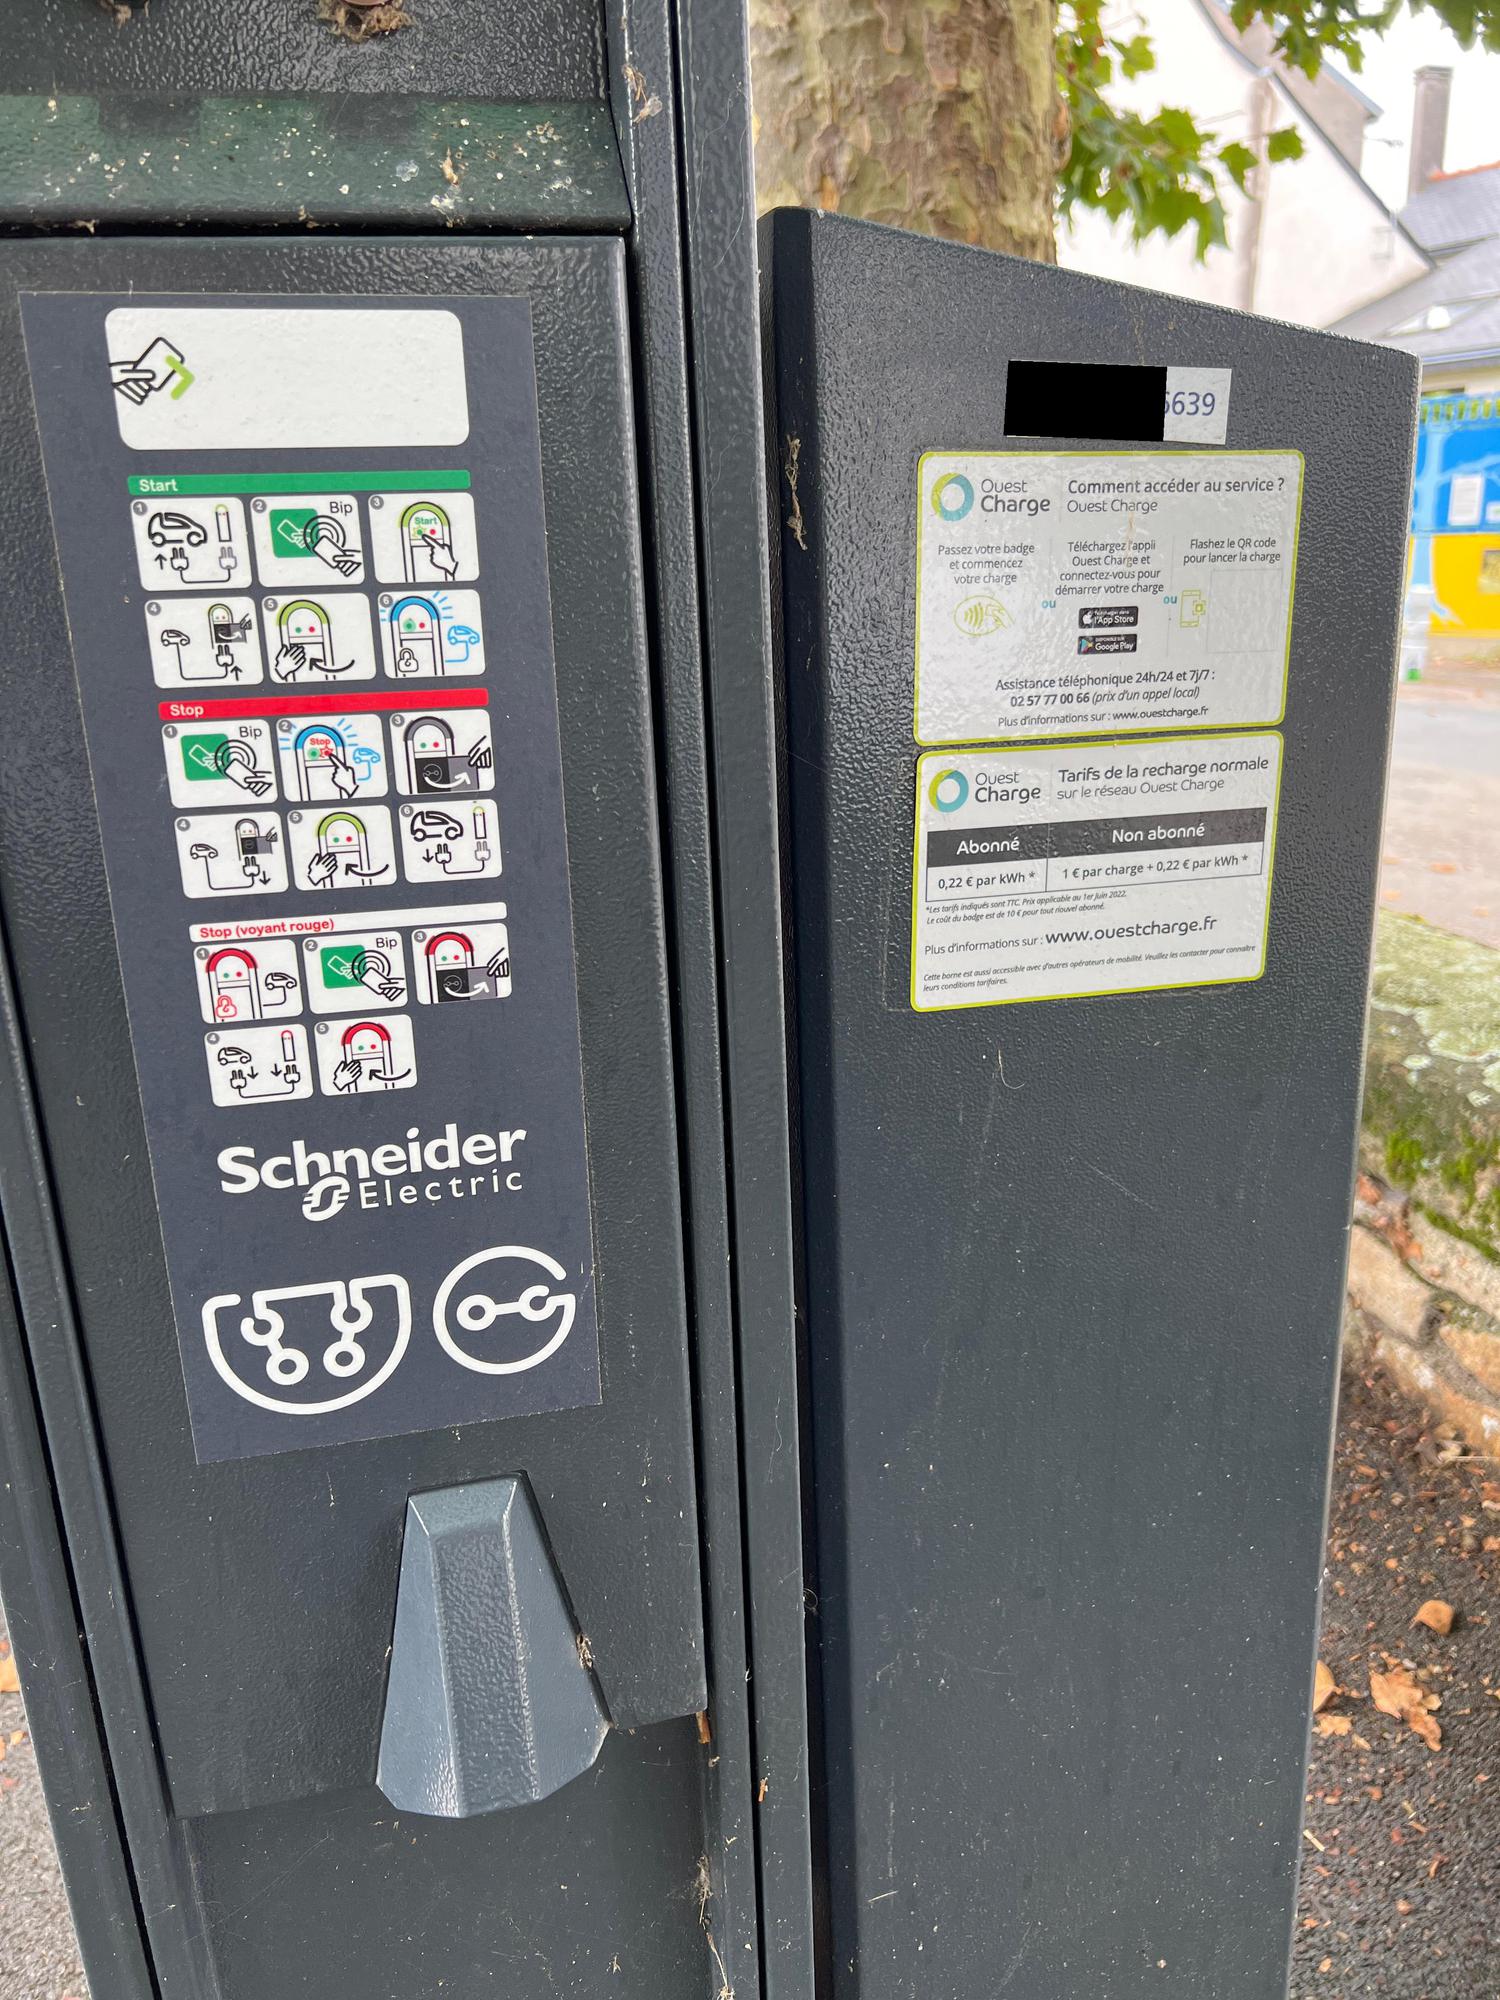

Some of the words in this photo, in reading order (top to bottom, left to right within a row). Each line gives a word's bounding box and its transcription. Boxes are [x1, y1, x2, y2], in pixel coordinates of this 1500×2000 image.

[139, 479, 178, 492] Start
[981, 479, 1027, 493] Ouest
[1068, 480, 1140, 493] Comment
[1144, 478, 1199, 493] accéder
[1204, 482, 1221, 491] au
[1225, 478, 1273, 491] service
[1278, 478, 1284, 491] ?
[330, 501, 352, 515] Bip
[981, 495, 1050, 516] Charge
[1067, 500, 1106, 512] Ouest
[1111, 499, 1158, 514] Charge
[415, 517, 438, 525] Start
[938, 545, 972, 555] Passez
[975, 545, 1001, 554] votre
[1003, 543, 1035, 556] badge
[1068, 541, 1126, 553] Téléchargez
[1190, 539, 1224, 549] Flashez
[1227, 538, 1235, 548] le
[1238, 538, 1251, 550] QR
[1254, 538, 1276, 547] code
[950, 561, 959, 569] et
[962, 559, 1022, 569] commencez
[1072, 556, 1101, 566] Ouest
[1104, 555, 1138, 567] Charge
[1141, 556, 1150, 564] et
[1184, 555, 1206, 566] pour
[1209, 552, 1237, 562] lancer
[1240, 552, 1246, 561] la
[1250, 552, 1280, 564] charge
[954, 575, 980, 584] votre
[983, 573, 1017, 585] charge
[1060, 571, 1135, 580] connectez-vous
[1138, 570, 1161, 580] pour
[1056, 586, 1101, 595] démarrer
[1104, 585, 1129, 593] votre
[1132, 583, 1164, 594] charge
[1042, 600, 1056, 608] ou
[1163, 596, 1177, 604] ou
[1095, 643, 1119, 651] Google
[1120, 642, 1133, 650] Play
[996, 679, 1055, 690] Assistance
[1058, 673, 1133, 689] téléphonique
[1136, 671, 1173, 683] 24h/24
[1176, 671, 1187, 681] et
[1190, 670, 1209, 683] 7j/7
[1011, 696, 1024, 707] 02
[1027, 695, 1041, 706] 57
[1044, 694, 1057, 705] 77
[1060, 694, 1073, 704] 00
[1076, 693, 1089, 702] 66
[1092, 691, 1116, 705] (prix
[1143, 688, 1171, 702] appel
[1173, 686, 1199, 699] local)
[170, 705, 204, 718] Stop
[999, 718, 1018, 726] Plus
[1090, 714, 1106, 722] sur
[1113, 706, 1208, 720] www.ouestcharge.fr
[240, 727, 262, 739] Bip
[1059, 768, 1100, 783] Tarifs
[1104, 766, 1122, 779] de
[1127, 764, 1138, 778] la
[1143, 762, 1206, 778] recharge
[1210, 757, 1268, 772] normale
[976, 772, 1020, 785] Ouest
[975, 787, 1041, 804] Charge
[1057, 789, 1078, 799] sur
[1082, 786, 1091, 798] le
[1095, 785, 1137, 797] réseau
[1140, 781, 1178, 793] Ouest
[1181, 778, 1224, 791] Charge
[1113, 829, 1143, 843] Non
[1148, 823, 1205, 840] abonné
[957, 837, 1020, 855] Abonné
[1063, 869, 1068, 878] 1
[1072, 868, 1079, 878] €
[1083, 867, 1102, 880] par
[1105, 863, 1143, 876] charge
[1157, 860, 1179, 873] 0,22
[1183, 859, 1190, 869] €
[1192, 858, 1210, 871] par
[1215, 855, 1239, 866] kWh
[938, 877, 963, 890] 0,22
[967, 877, 973, 886] €
[977, 876, 996, 888] par
[1000, 873, 1025, 884] kWh
[942, 904, 959, 913] tarifs
[961, 902, 989, 911] indiqués
[1037, 895, 1071, 905] applicable
[963, 914, 984, 922] badge
[1022, 909, 1038, 917] pour
[1055, 905, 1077, 913] nouvel
[200, 928, 232, 938] Stop
[236, 922, 286, 937] (voyant
[291, 919, 334, 932] rouge)
[925, 944, 945, 955] Plus
[1022, 938, 1038, 946] sur
[1045, 916, 1217, 944] www.ouestcharge.fr
[376, 938, 397, 949] Bip
[993, 965, 1025, 974] accessible
[1070, 959, 1104, 968] opérateurs
[1180, 949, 1209, 957] contacter
[1209, 948, 1225, 956] pour
[941, 981, 975, 990] conditions
[217, 1124, 527, 1194] Schneider
[359, 1169, 523, 1209] Electric
